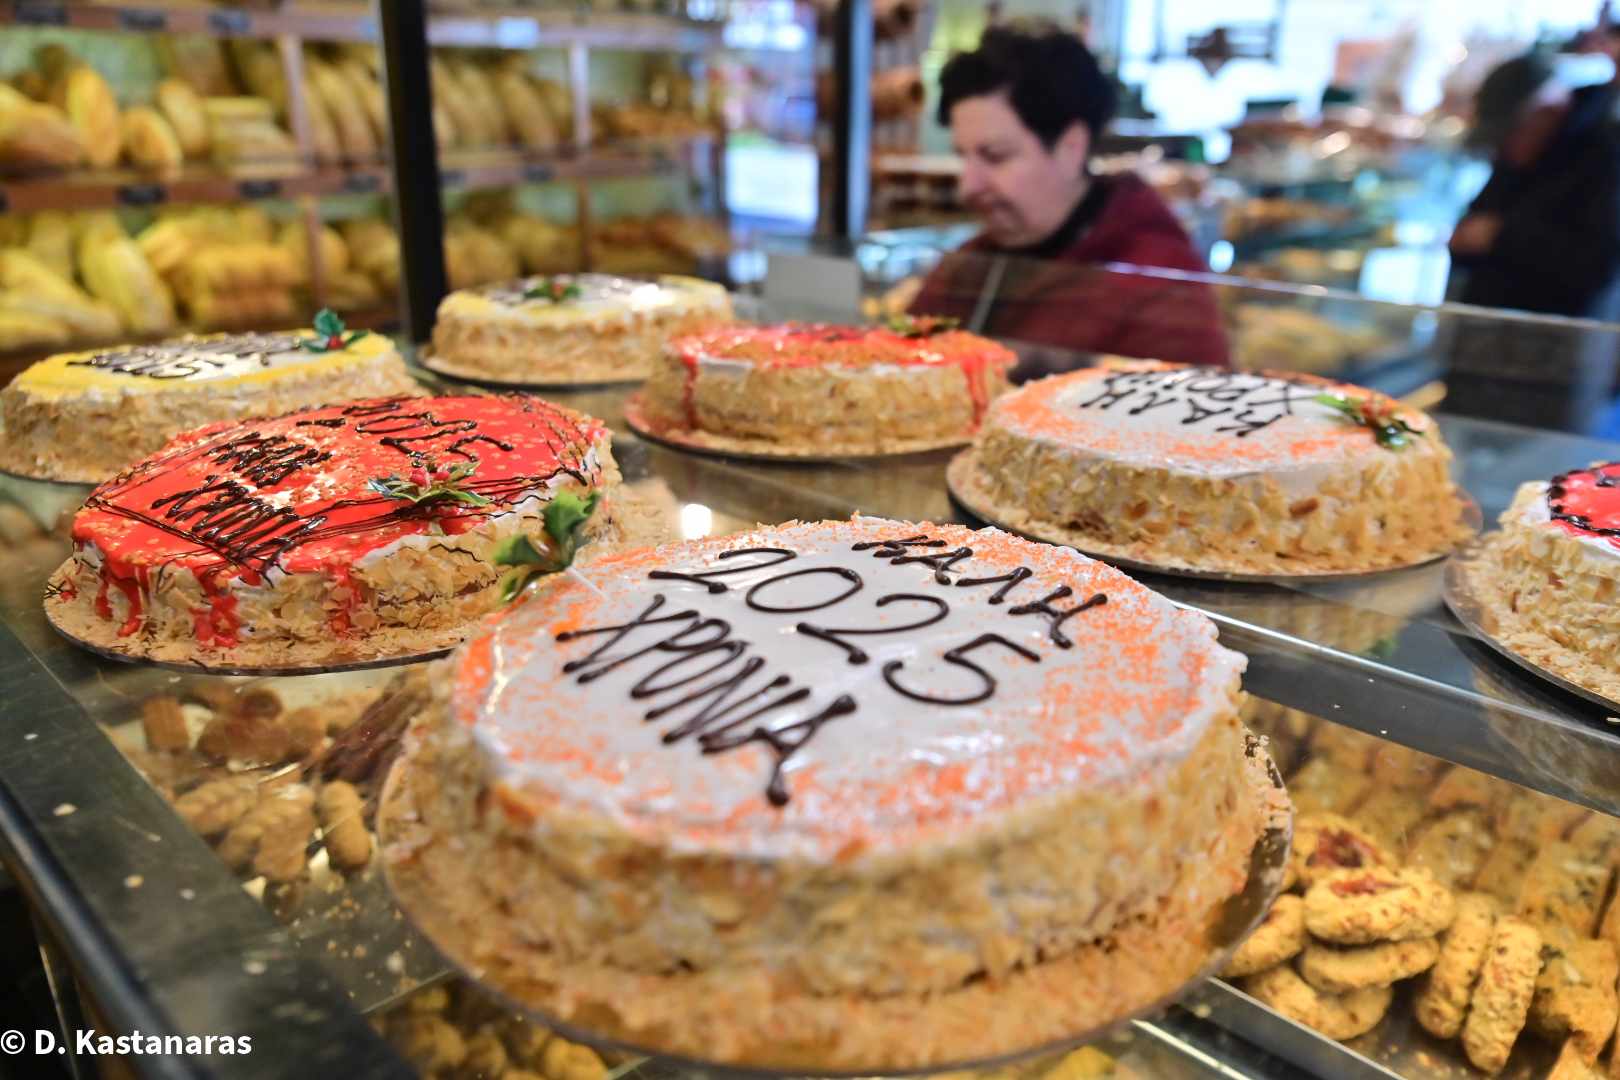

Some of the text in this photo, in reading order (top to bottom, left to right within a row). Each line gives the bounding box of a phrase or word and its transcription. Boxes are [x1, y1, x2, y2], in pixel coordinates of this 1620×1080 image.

[648, 547, 1041, 706] 2025
[851, 534, 1108, 649] ΚΑΛΗ
[555, 593, 857, 807] ΧΡΟΝΙΑ
